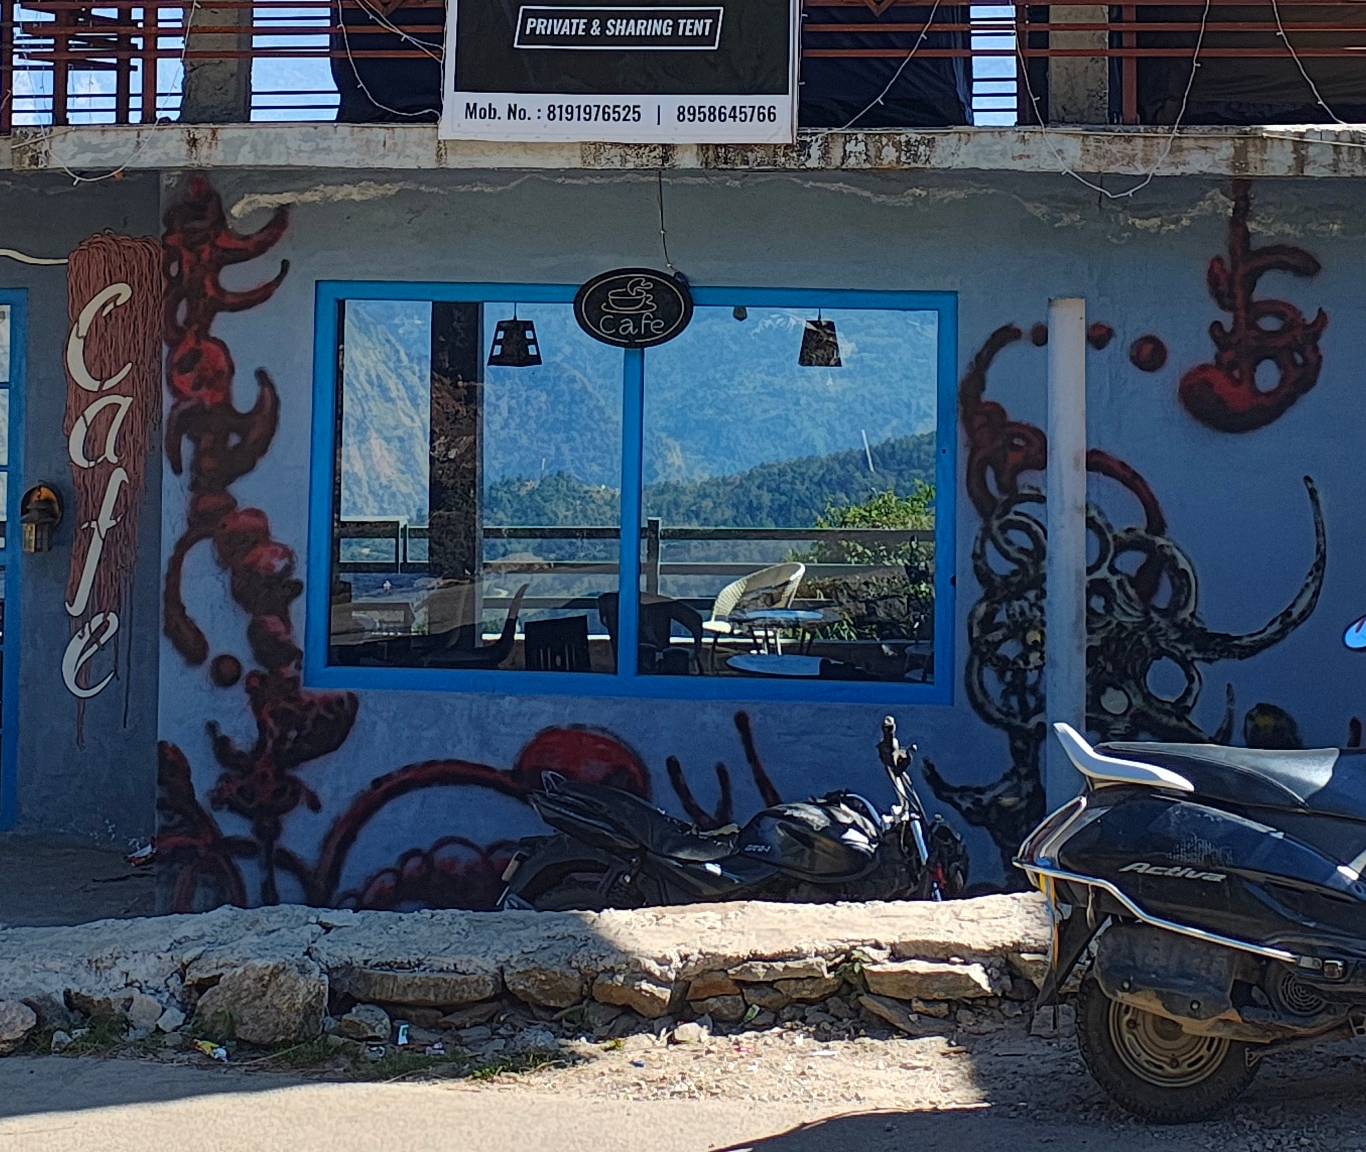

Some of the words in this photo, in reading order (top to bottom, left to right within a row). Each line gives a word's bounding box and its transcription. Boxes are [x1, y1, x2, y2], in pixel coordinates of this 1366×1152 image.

[525, 18, 587, 36] PRIVATE
[590, 19, 601, 36] &
[605, 18, 672, 37] SHARING
[676, 18, 713, 37] TENT
[464, 102, 501, 120] Mob.
[507, 103, 532, 121] No.
[546, 104, 642, 123] 8191976525
[676, 105, 777, 123] 8958645766
[599, 312, 665, 335] Cafe
[1118, 862, 1227, 882] Activa
